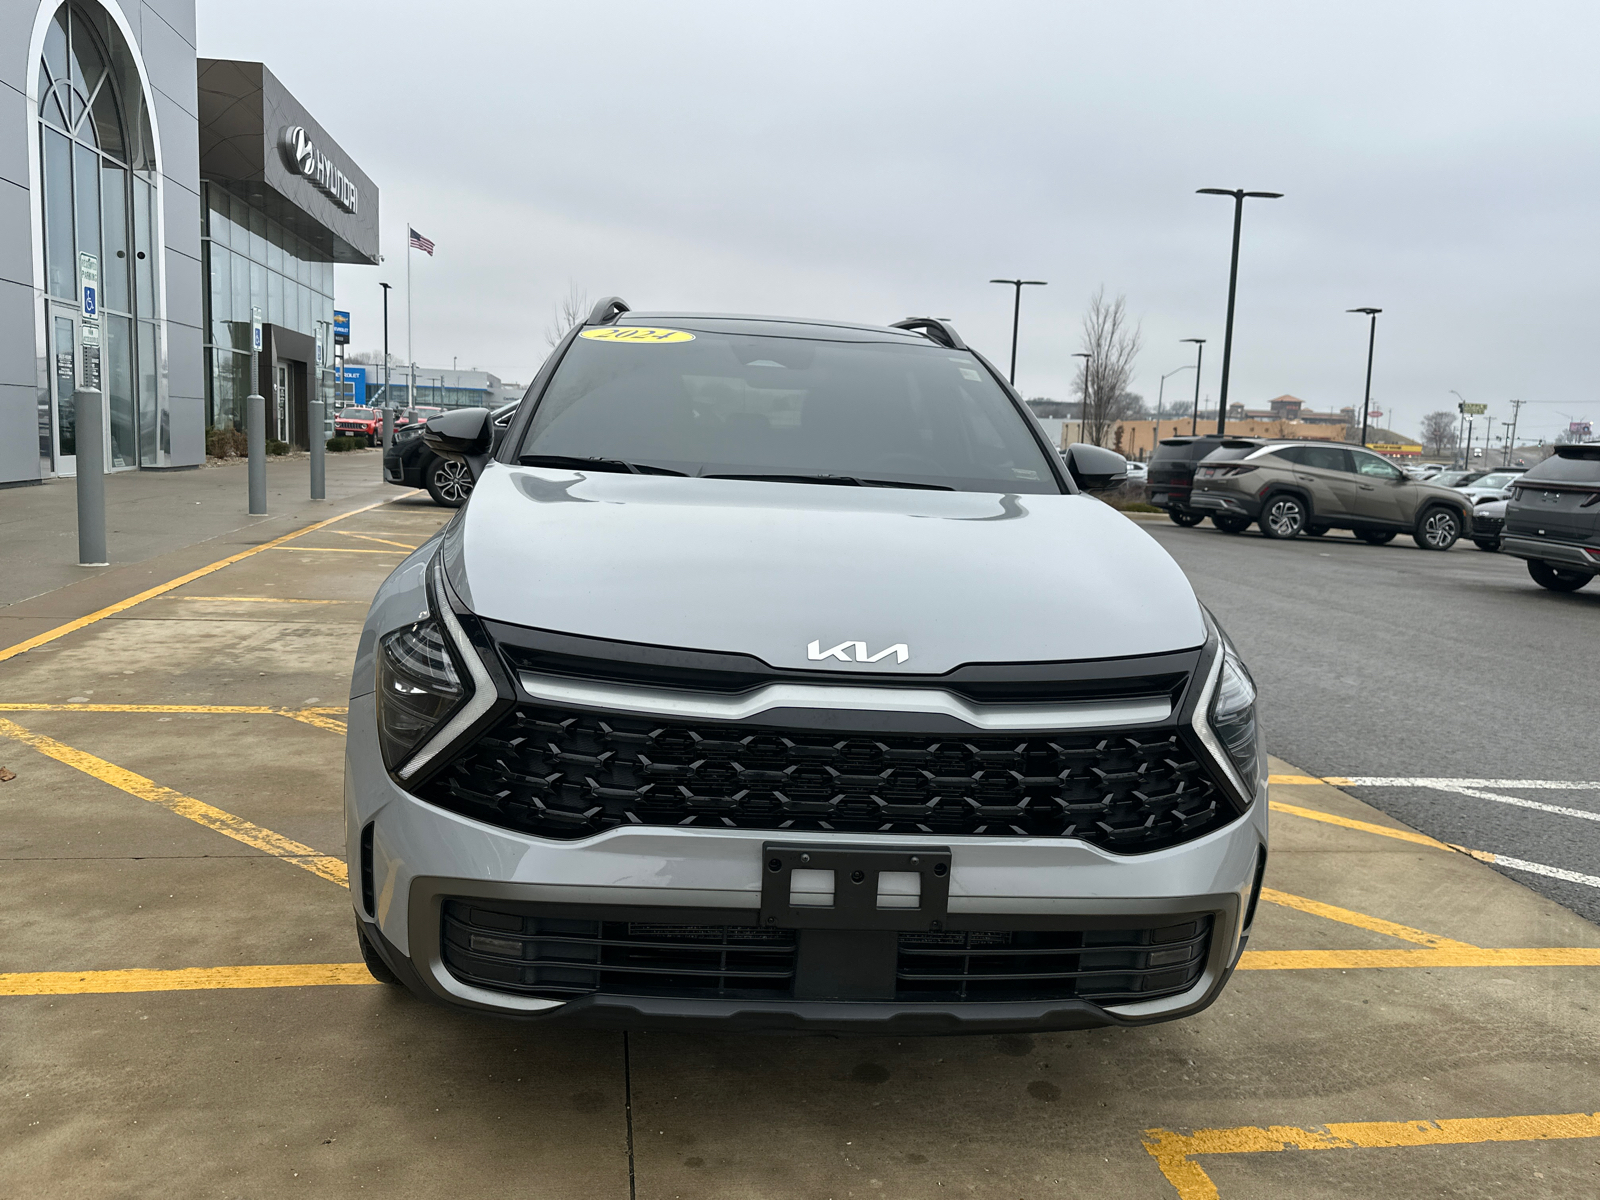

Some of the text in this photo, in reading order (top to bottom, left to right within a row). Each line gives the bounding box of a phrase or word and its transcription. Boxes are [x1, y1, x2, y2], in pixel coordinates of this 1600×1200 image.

[316, 149, 358, 214] HYUNDAI
[594, 329, 678, 340] 2024
[807, 639, 909, 665] KIA
